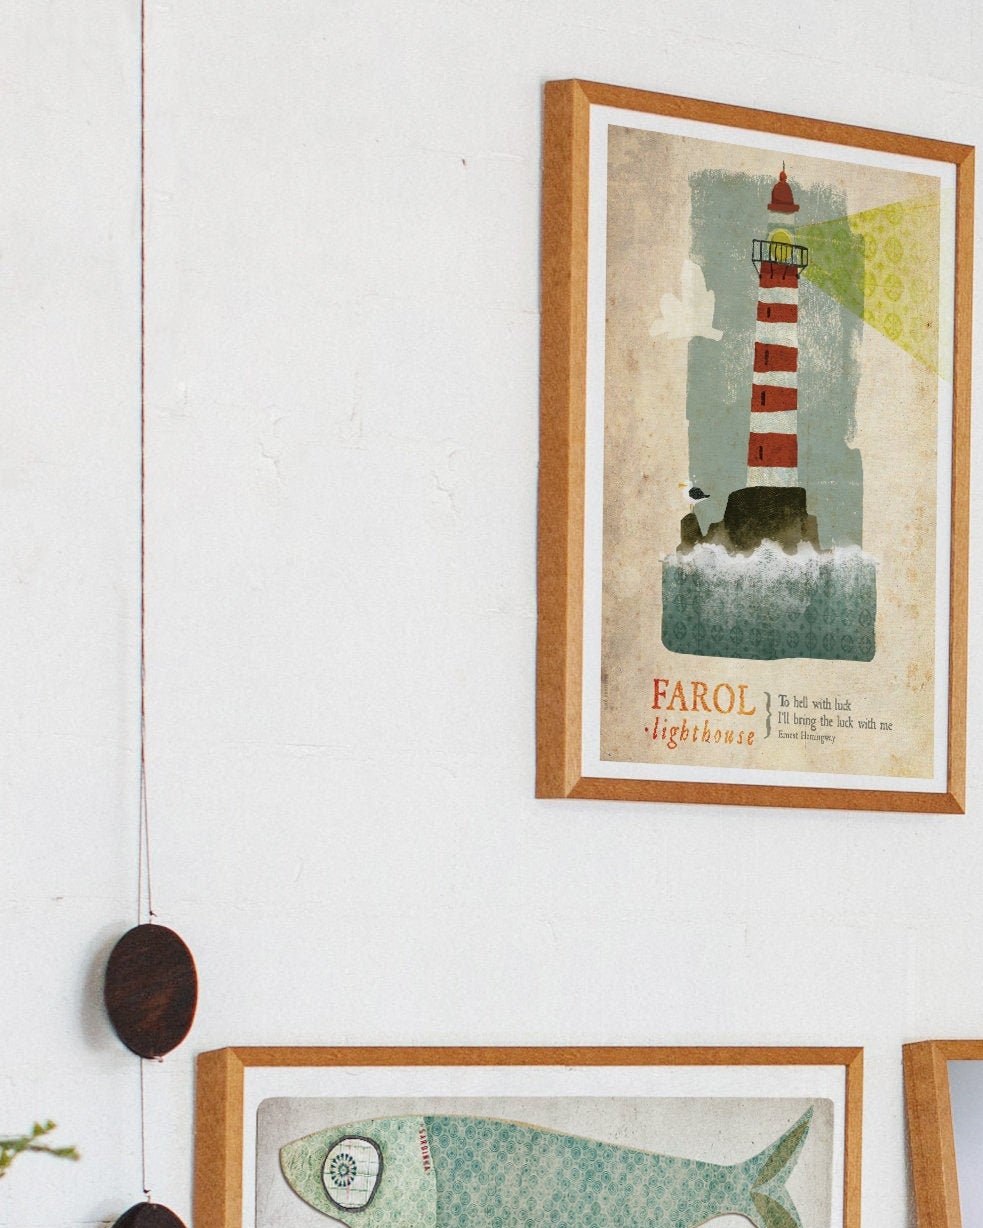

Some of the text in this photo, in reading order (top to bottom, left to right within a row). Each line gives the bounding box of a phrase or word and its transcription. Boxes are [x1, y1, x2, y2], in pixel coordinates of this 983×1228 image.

[652, 679, 756, 716] FAROL
[778, 694, 852, 711] To hell with luck
[778, 712, 893, 731] I'll bring the luck with me
